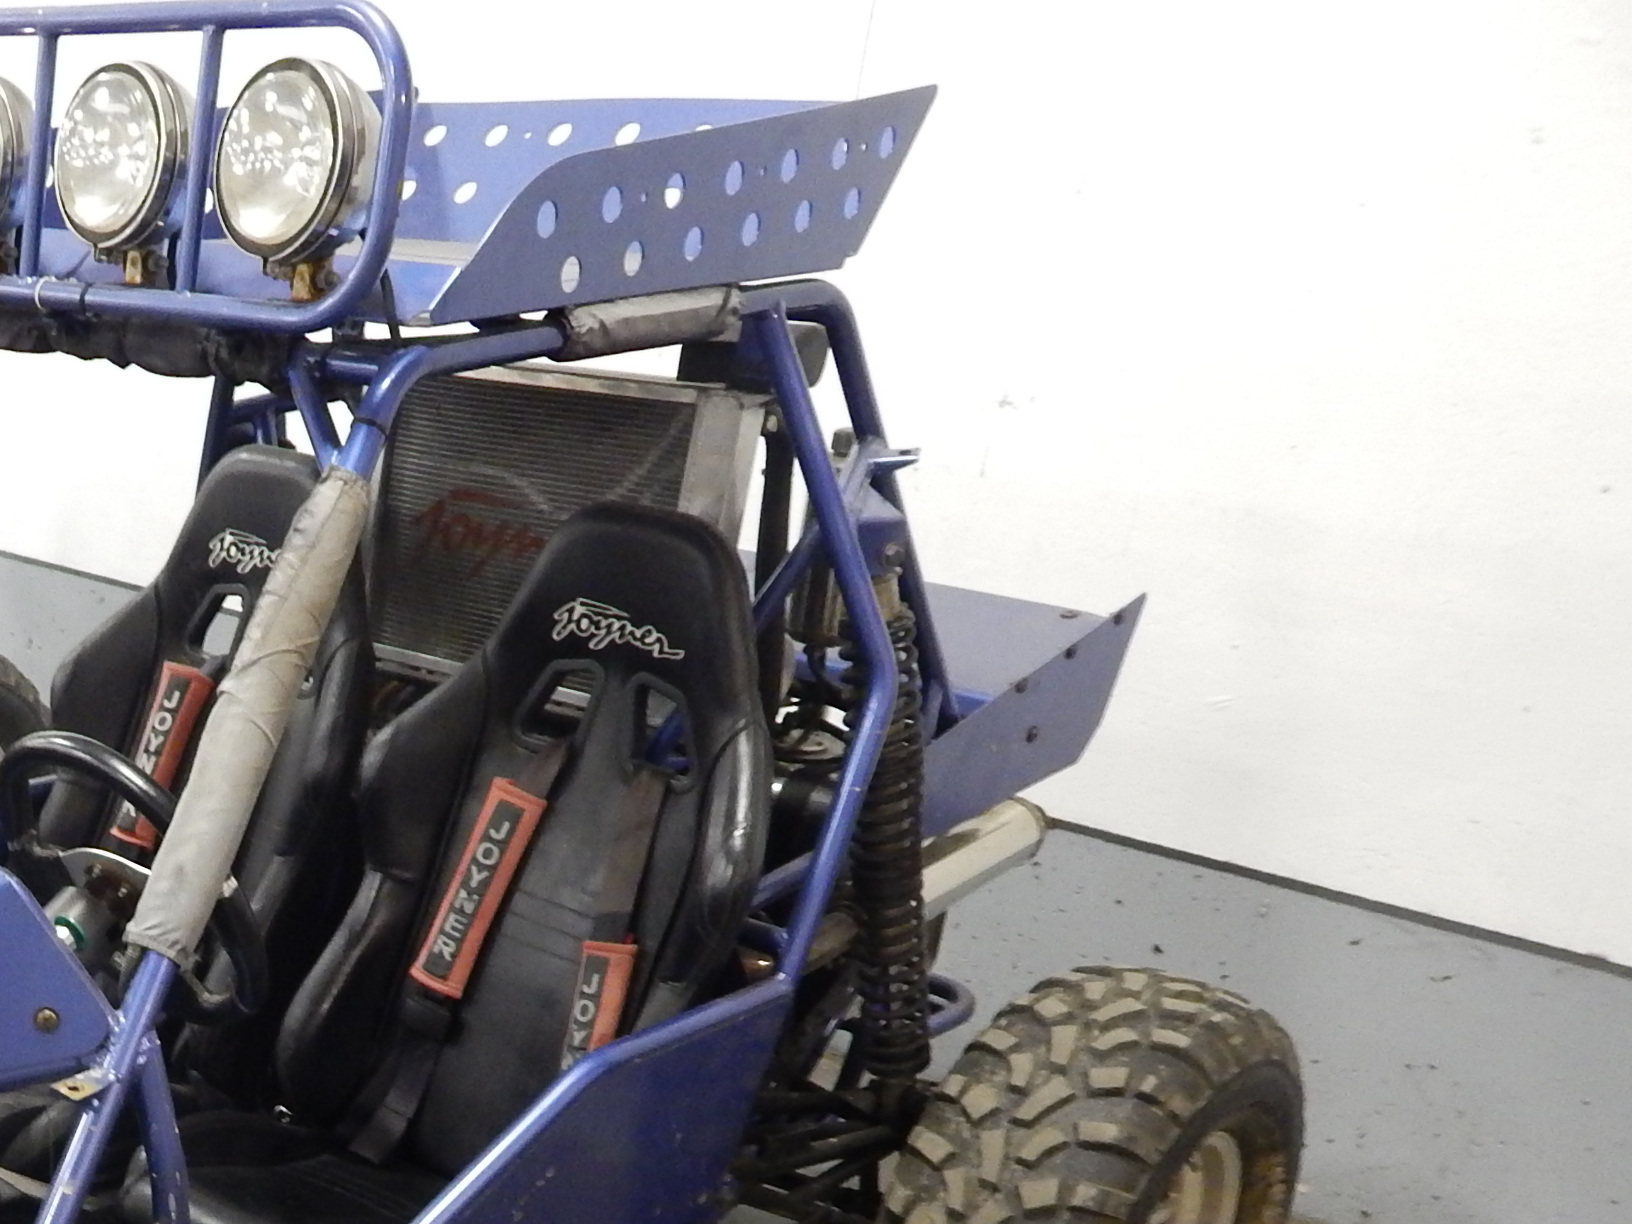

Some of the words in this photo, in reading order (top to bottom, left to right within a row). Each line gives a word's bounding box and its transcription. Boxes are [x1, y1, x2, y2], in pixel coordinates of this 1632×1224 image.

[208, 528, 282, 574] Joyn
[552, 597, 685, 660] Joyner
[433, 820, 510, 962] JOYNER
